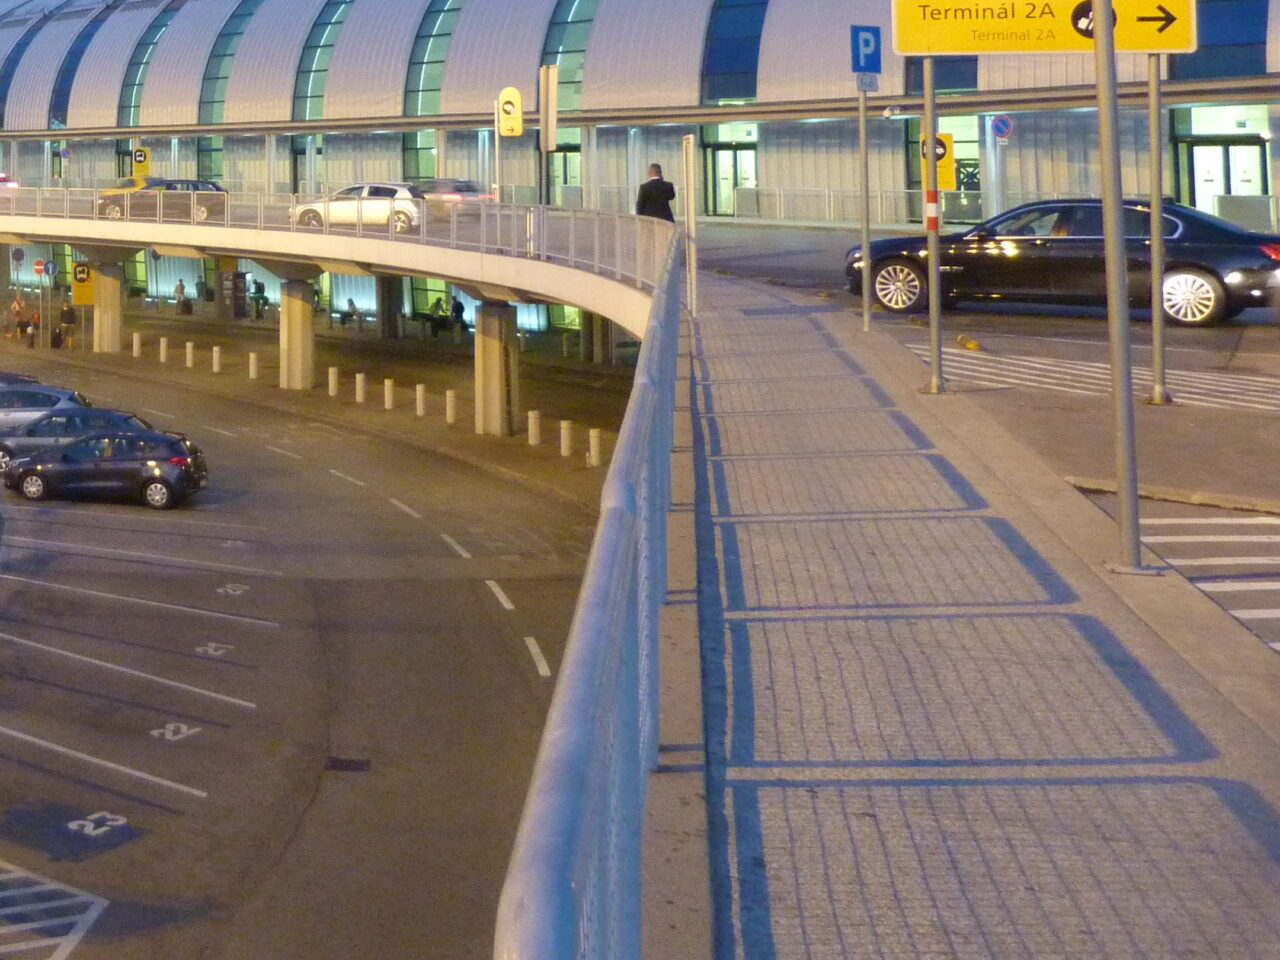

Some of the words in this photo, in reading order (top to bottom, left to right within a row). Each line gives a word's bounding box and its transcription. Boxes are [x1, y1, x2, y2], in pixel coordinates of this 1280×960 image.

[918, 2, 1015, 21] Terminál
[1025, 2, 1056, 19] 2A
[971, 29, 1031, 41] Terminal
[1036, 28, 1056, 41] 2A
[858, 31, 875, 67] P
[67, 811, 128, 836] 23
